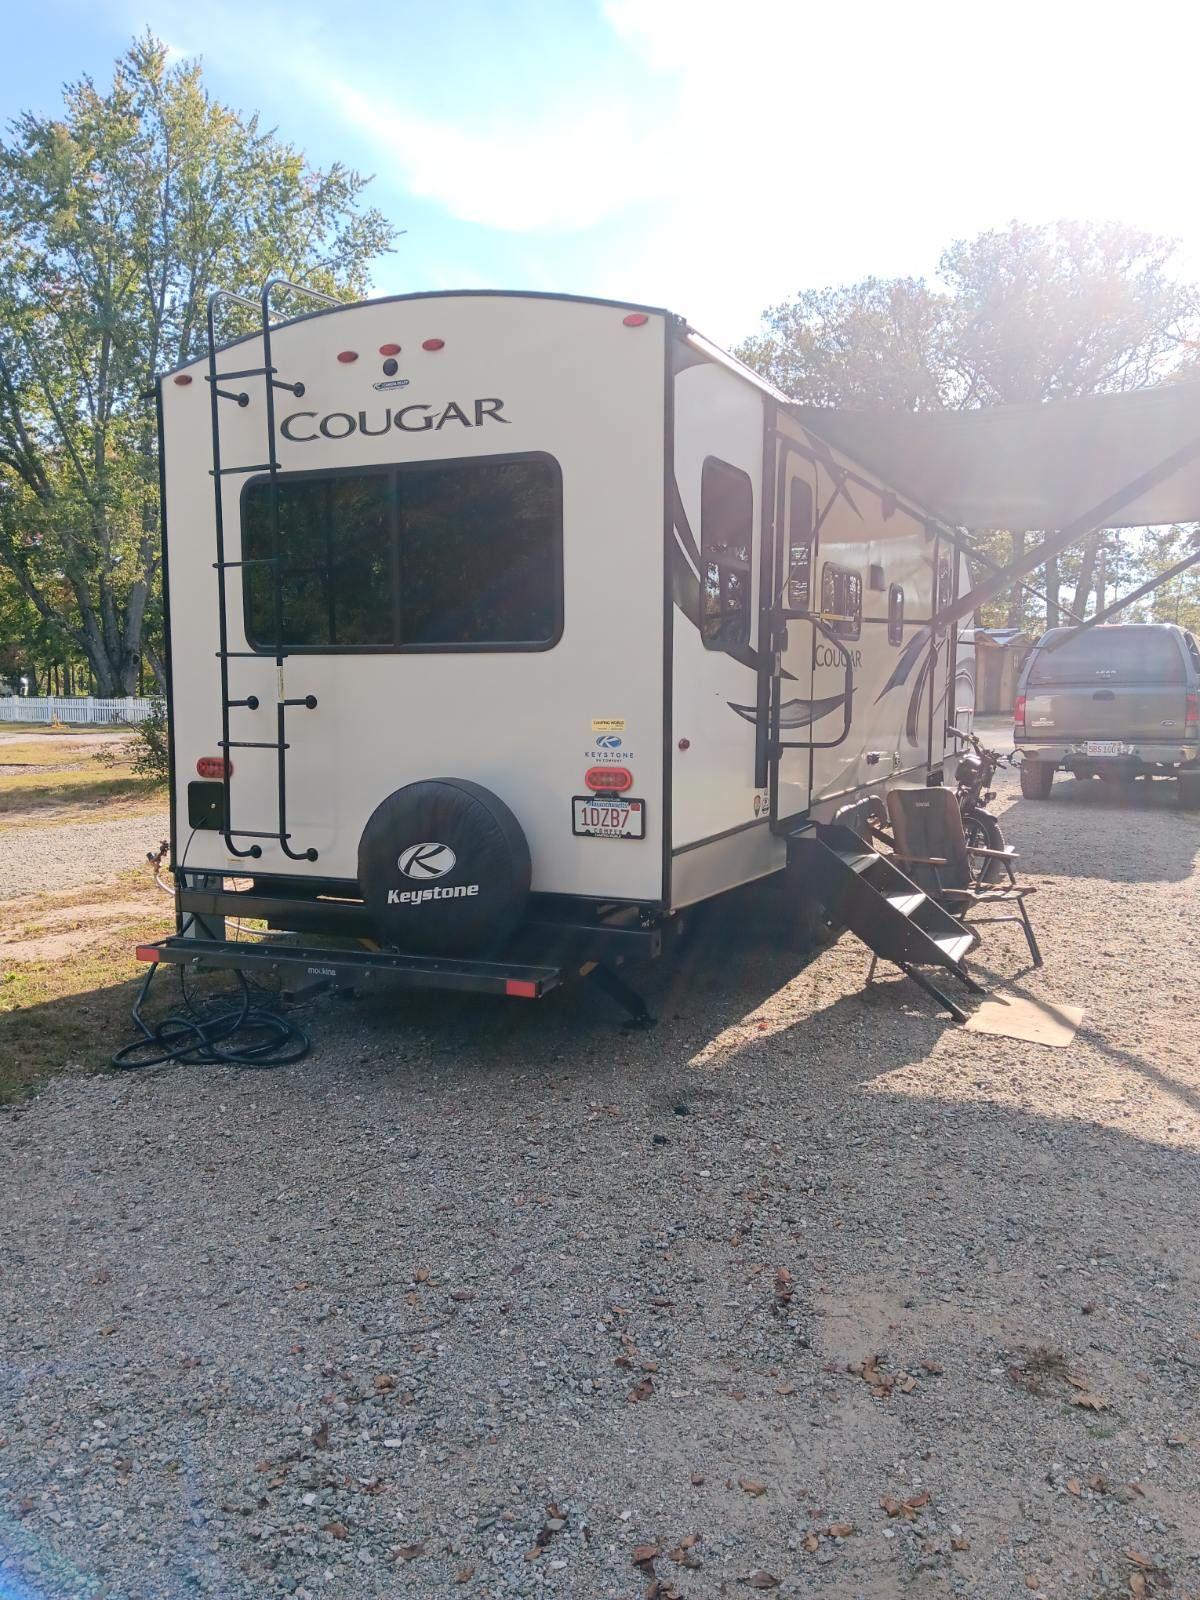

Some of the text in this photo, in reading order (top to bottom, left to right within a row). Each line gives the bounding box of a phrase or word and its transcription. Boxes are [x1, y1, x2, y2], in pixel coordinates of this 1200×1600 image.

[280, 398, 512, 442] COUGAR
[584, 751, 634, 759] KEYSTONE
[581, 807, 630, 828] 1DZB7
[387, 884, 479, 905] Keystone
